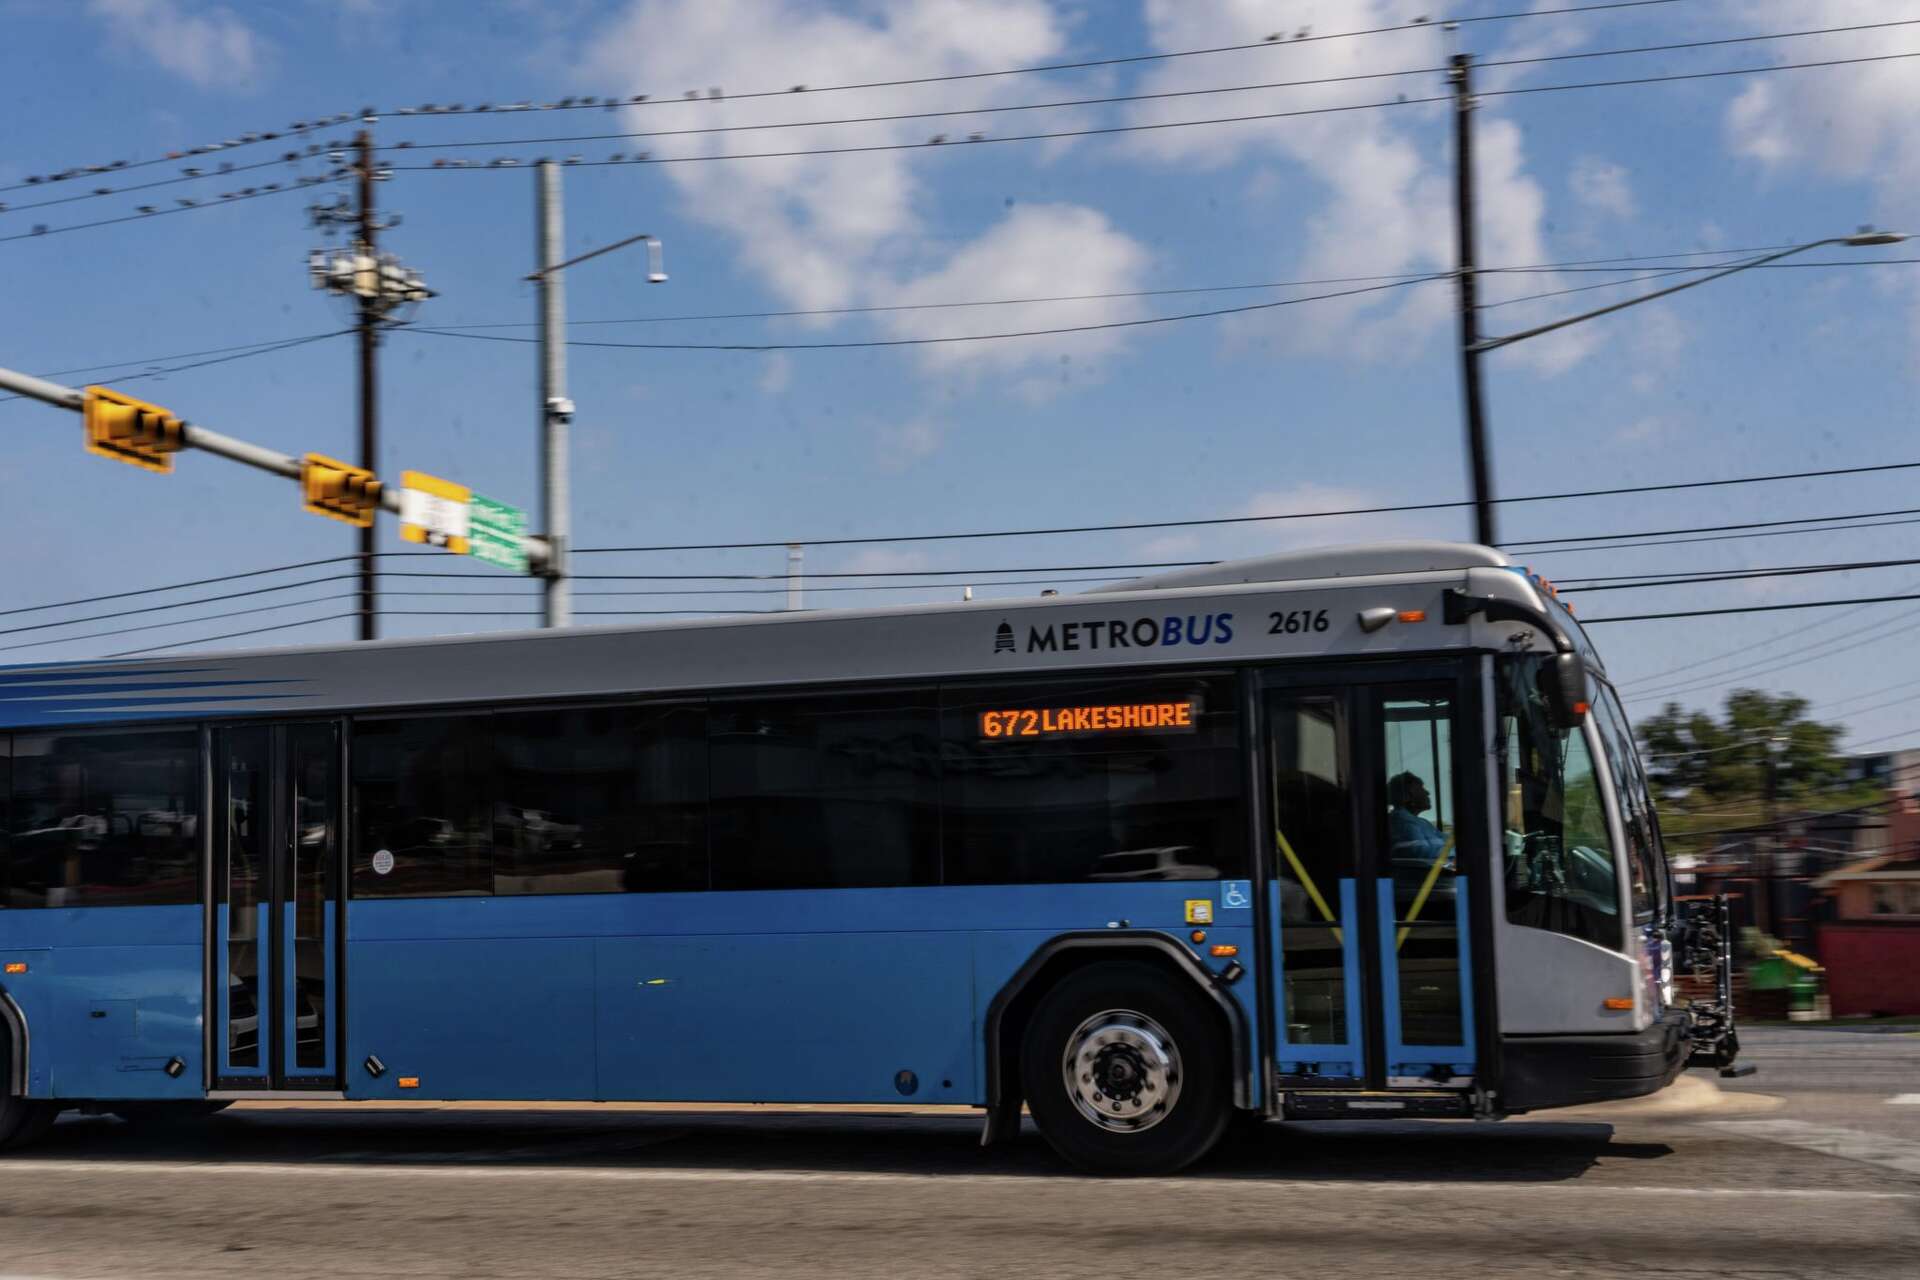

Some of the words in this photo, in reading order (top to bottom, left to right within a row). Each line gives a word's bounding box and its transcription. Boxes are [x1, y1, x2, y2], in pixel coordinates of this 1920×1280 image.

[1027, 612, 1234, 653] METROBUS
[1268, 609, 1330, 635] 2616
[983, 710, 1039, 736] 672
[1042, 703, 1192, 732] LAKESHORE
